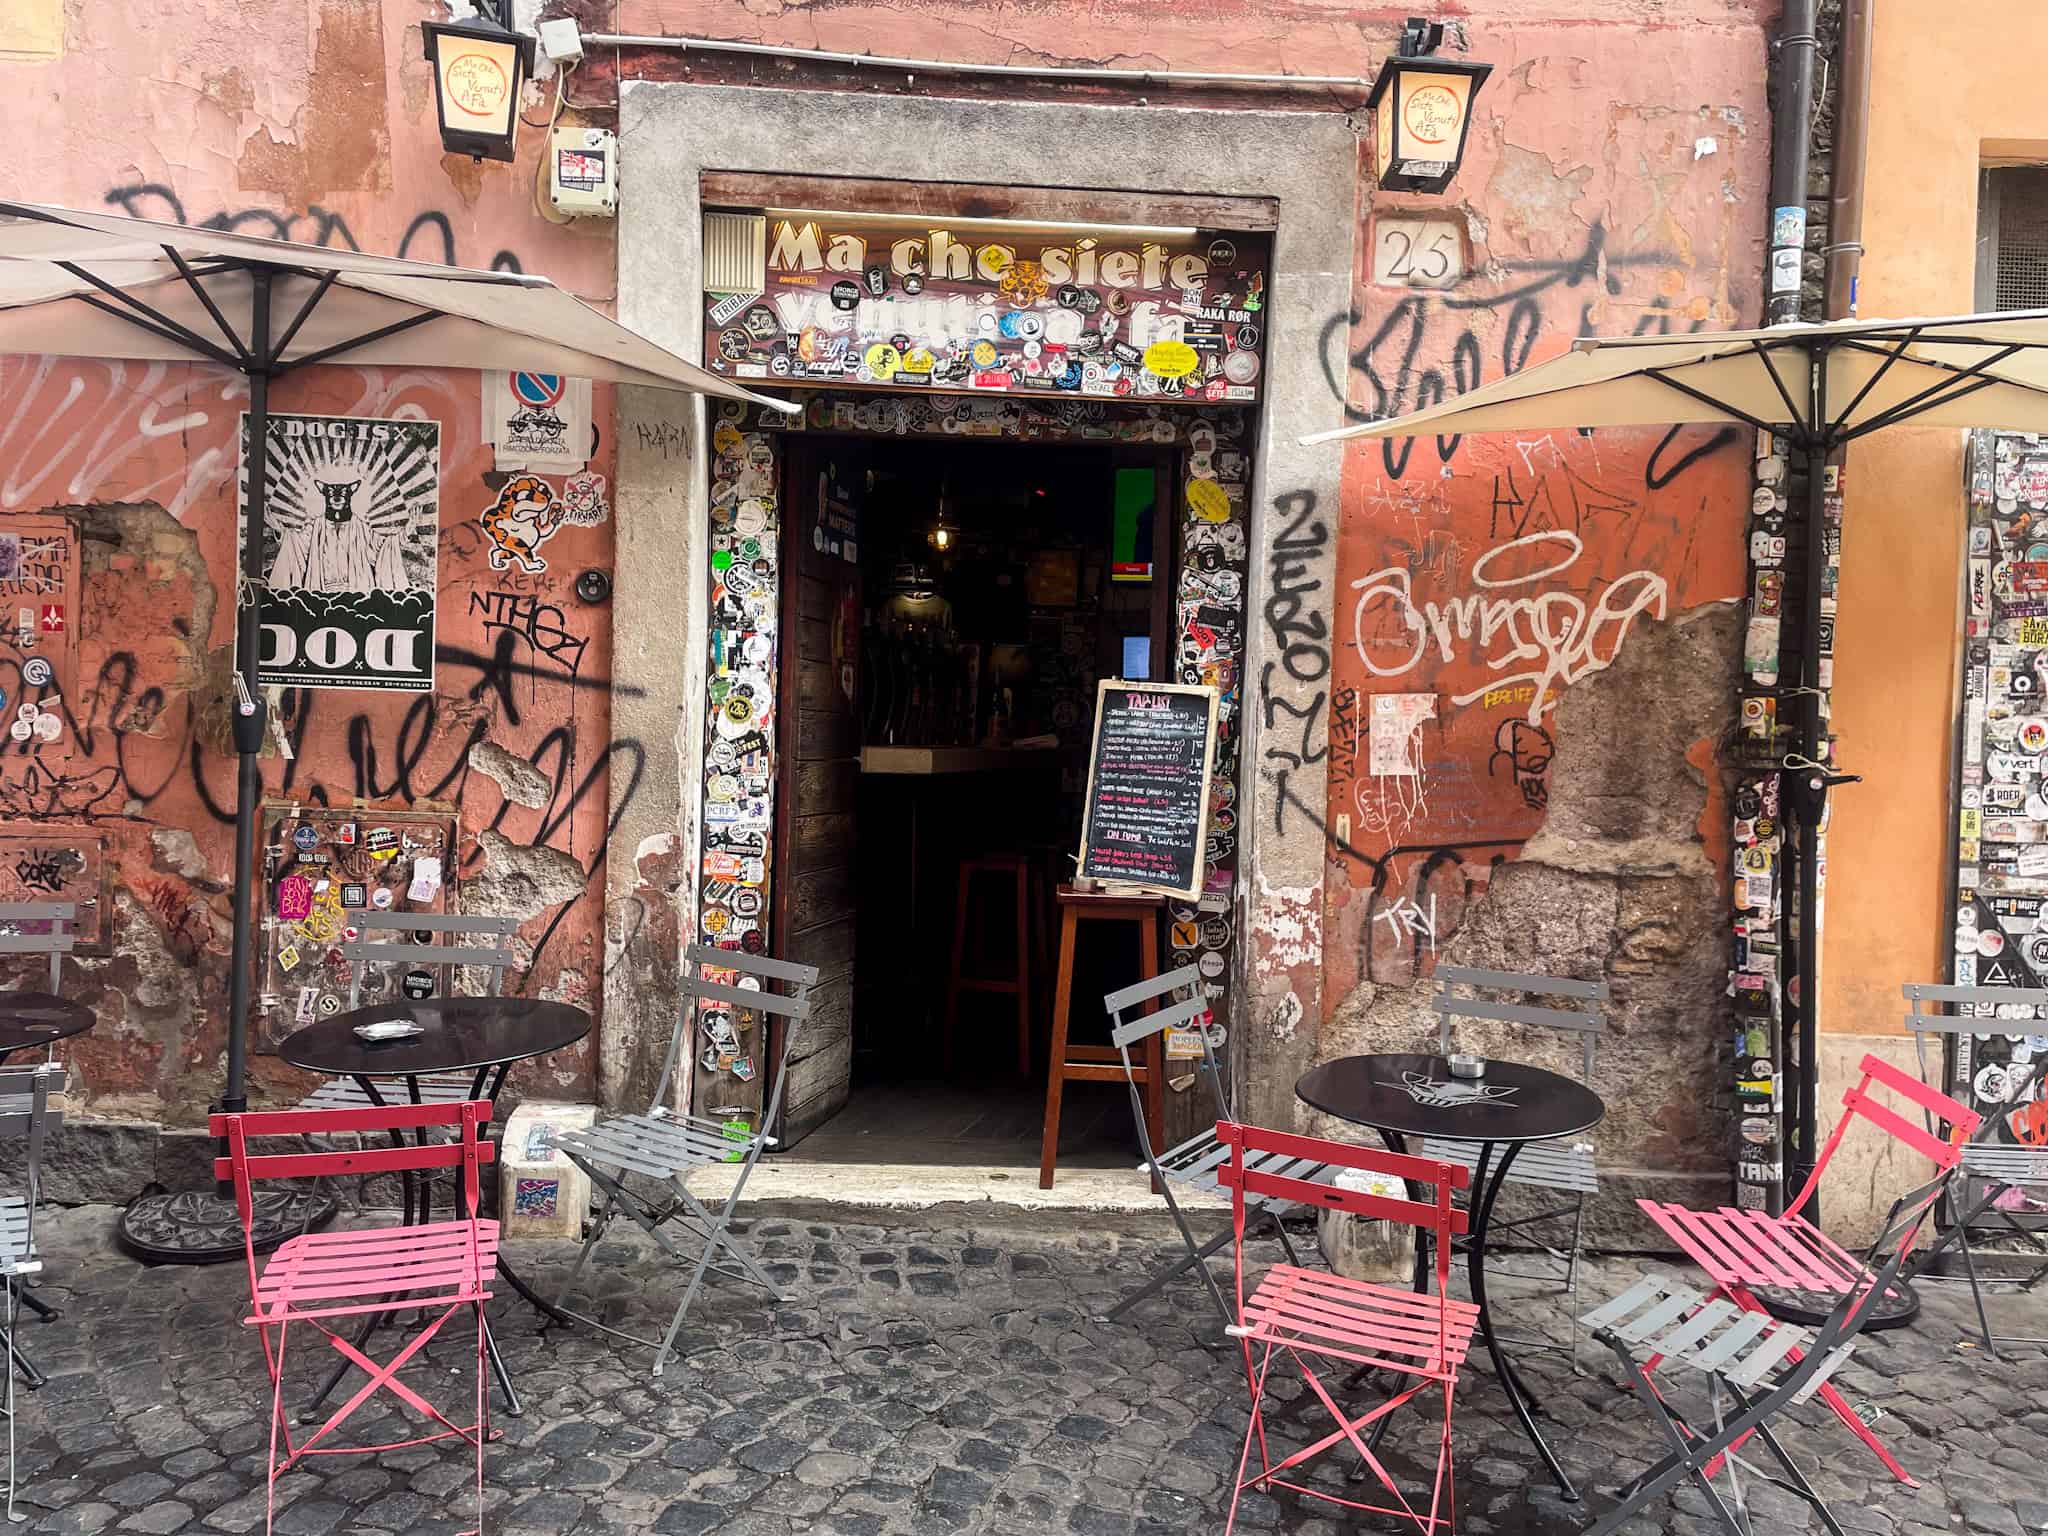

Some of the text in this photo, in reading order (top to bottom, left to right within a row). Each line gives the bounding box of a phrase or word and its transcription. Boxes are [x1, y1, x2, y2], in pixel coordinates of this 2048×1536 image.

[768, 220, 867, 273] Ma
[1040, 238, 1209, 291] siete
[1384, 230, 1449, 280] 25
[286, 420, 390, 441] DOG IS
[2024, 632, 2048, 645] BOR
[1151, 695, 1172, 711] LIST
[2011, 759, 2035, 769] vert
[2017, 900, 2039, 911] MUFF
